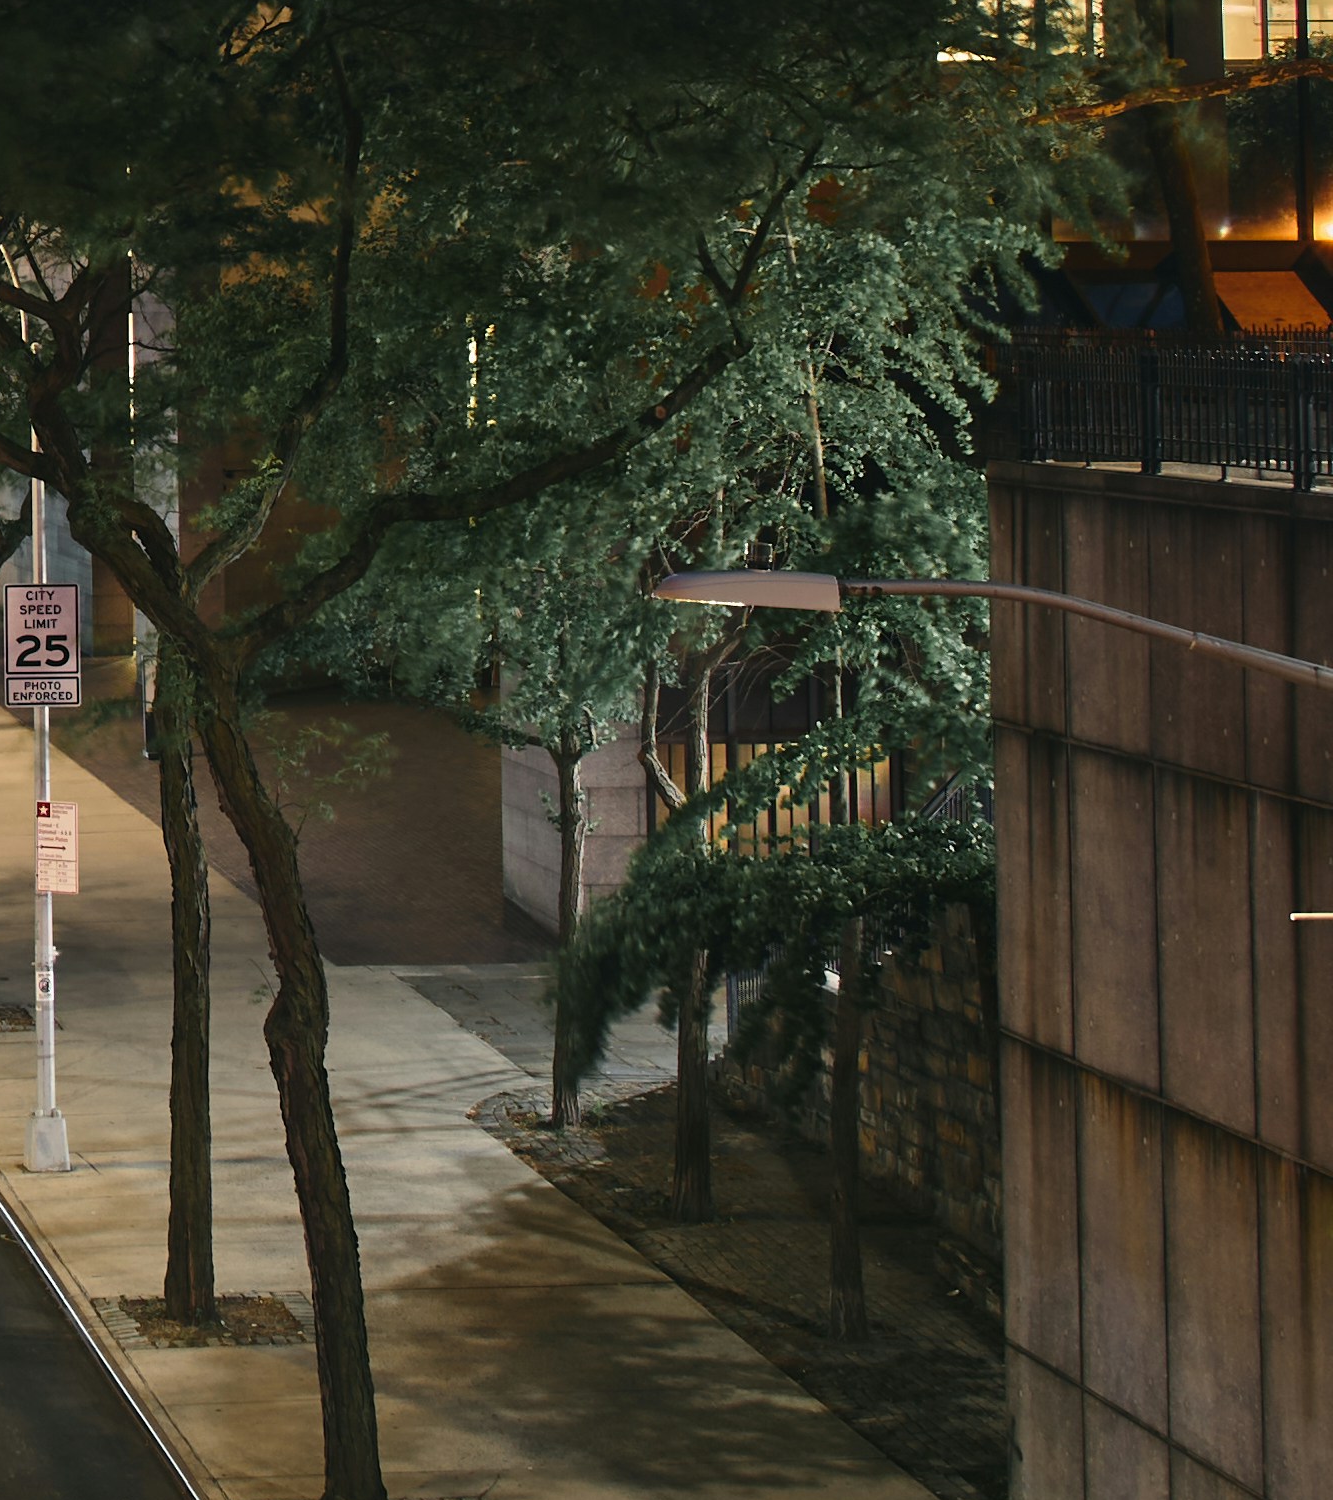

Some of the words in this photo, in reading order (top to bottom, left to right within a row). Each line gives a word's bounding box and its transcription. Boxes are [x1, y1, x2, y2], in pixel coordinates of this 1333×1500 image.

[25, 590, 55, 601] CITY
[19, 604, 62, 615] SPEED
[24, 618, 58, 629] LIMIT
[15, 634, 70, 667] 25
[24, 681, 61, 691] PHOTO
[13, 691, 73, 701] ENFORCED
